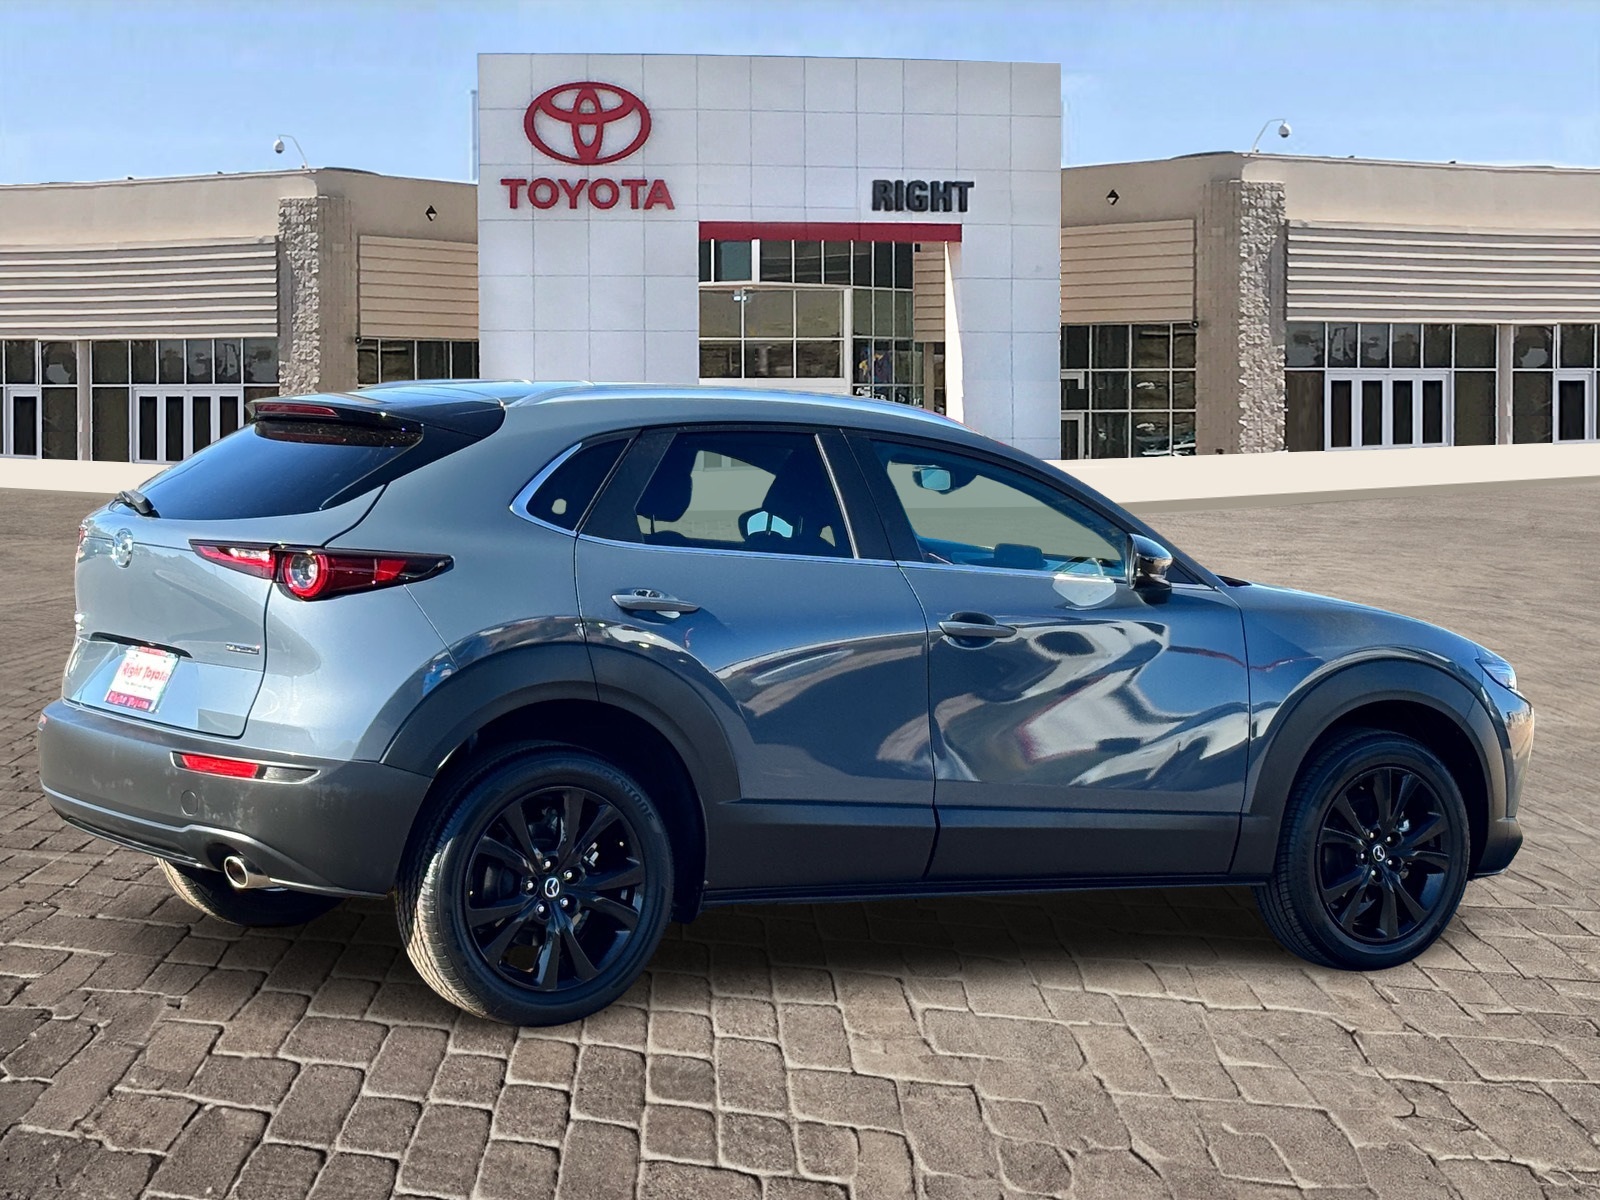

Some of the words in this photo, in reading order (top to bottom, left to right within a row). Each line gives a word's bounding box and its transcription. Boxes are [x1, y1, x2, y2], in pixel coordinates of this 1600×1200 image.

[500, 178, 675, 210] TOYOTA
[871, 179, 975, 212] RIGHT
[123, 662, 142, 677] Right
[143, 666, 169, 681] Toyota
